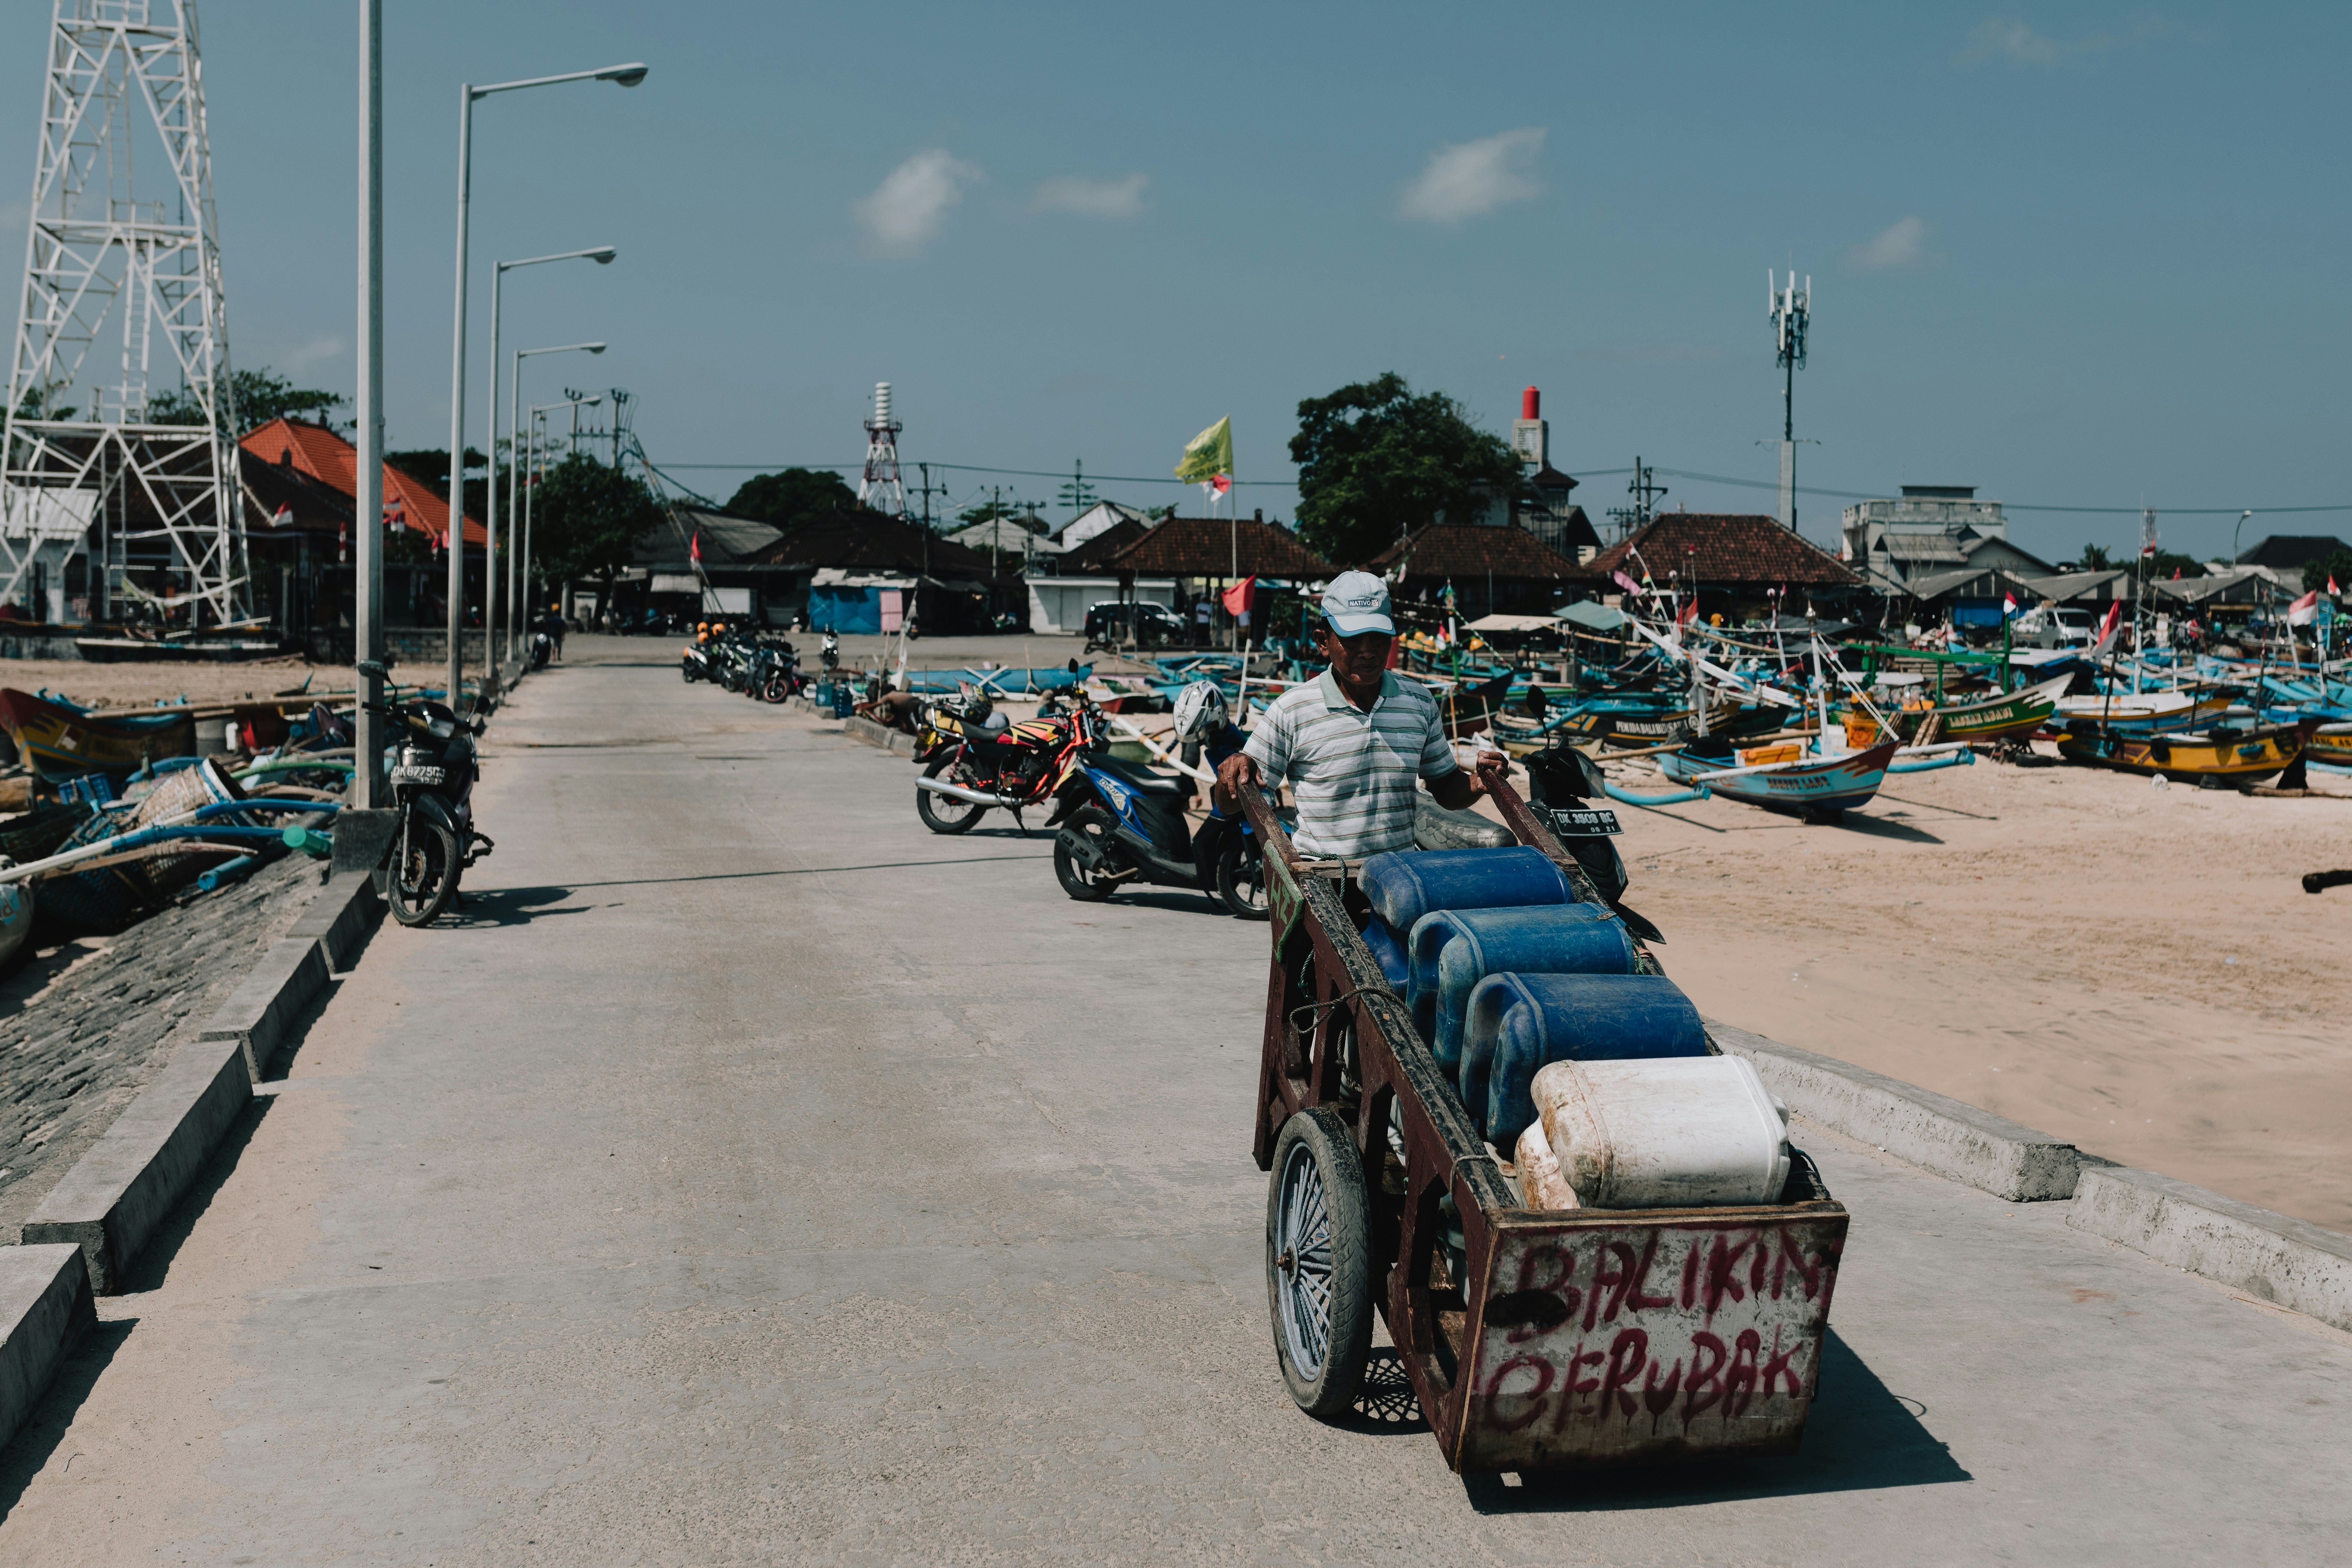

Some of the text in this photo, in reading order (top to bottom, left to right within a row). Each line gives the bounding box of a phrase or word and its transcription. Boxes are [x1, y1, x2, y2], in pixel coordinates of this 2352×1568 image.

[393, 766, 406, 776] DK
[1557, 813, 1572, 824] DK
[1599, 812, 1614, 823] BC
